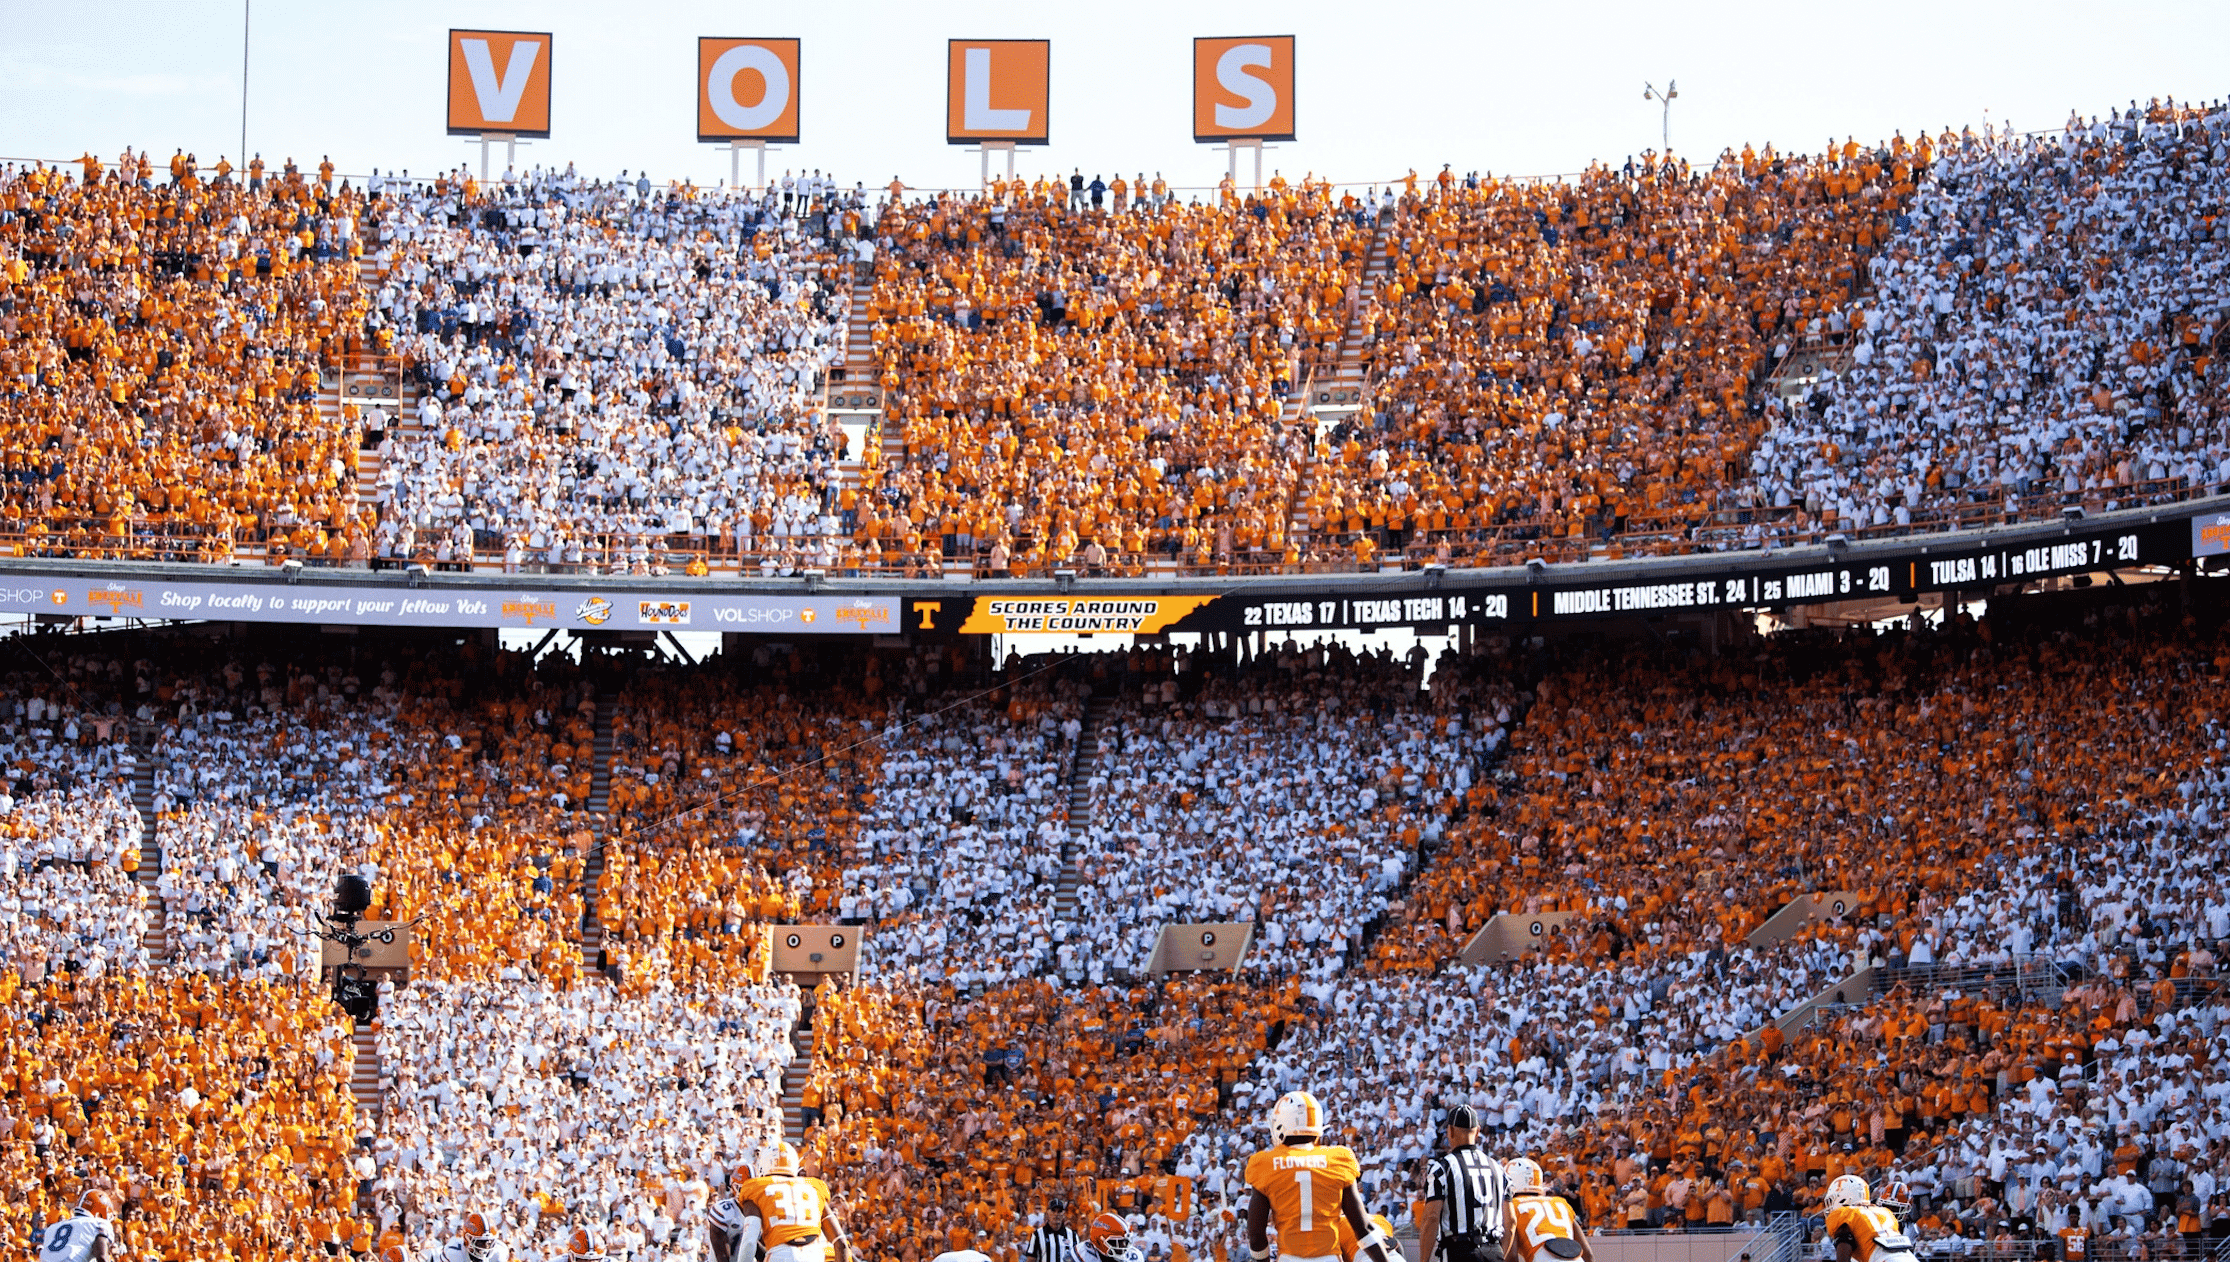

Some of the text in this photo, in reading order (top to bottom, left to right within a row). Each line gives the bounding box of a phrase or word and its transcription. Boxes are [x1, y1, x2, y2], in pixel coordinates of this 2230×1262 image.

[2012, 555, 2023, 574] 16
[2026, 548, 2049, 572] OLE
[2052, 542, 2087, 569] MISS
[2093, 540, 2101, 563] 7
[2119, 535, 2137, 560] 2Q
[1764, 581, 1781, 599] 25
[1787, 572, 1833, 598] MIAMI
[1840, 571, 1850, 593] 3
[1869, 567, 1889, 591] 2Q
[1931, 555, 1996, 584] TULSA 14
[161, 592, 486, 615] Shop locally to support your fellow Vols
[989, 601, 1157, 616] SCORES AROUND
[1353, 600, 1401, 622] TEXAS
[1404, 598, 1442, 621] TECH
[1449, 597, 1466, 618] 14
[1486, 595, 1507, 618] 2Q
[1555, 580, 1746, 614] MIDDLE TENNESSEE ST. 24
[913, 602, 941, 629] T
[1005, 616, 1144, 631] THE COUNTRY
[1245, 602, 1335, 625] 22 TEXAS 17
[833, 935, 842, 947] P
[1204, 934, 1213, 944] P
[1273, 1155, 1328, 1171] FLOWERS
[764, 1183, 823, 1227] 38
[1294, 1171, 1313, 1232] 1
[1517, 1201, 1574, 1247] 24
[48, 1224, 73, 1252] 8
